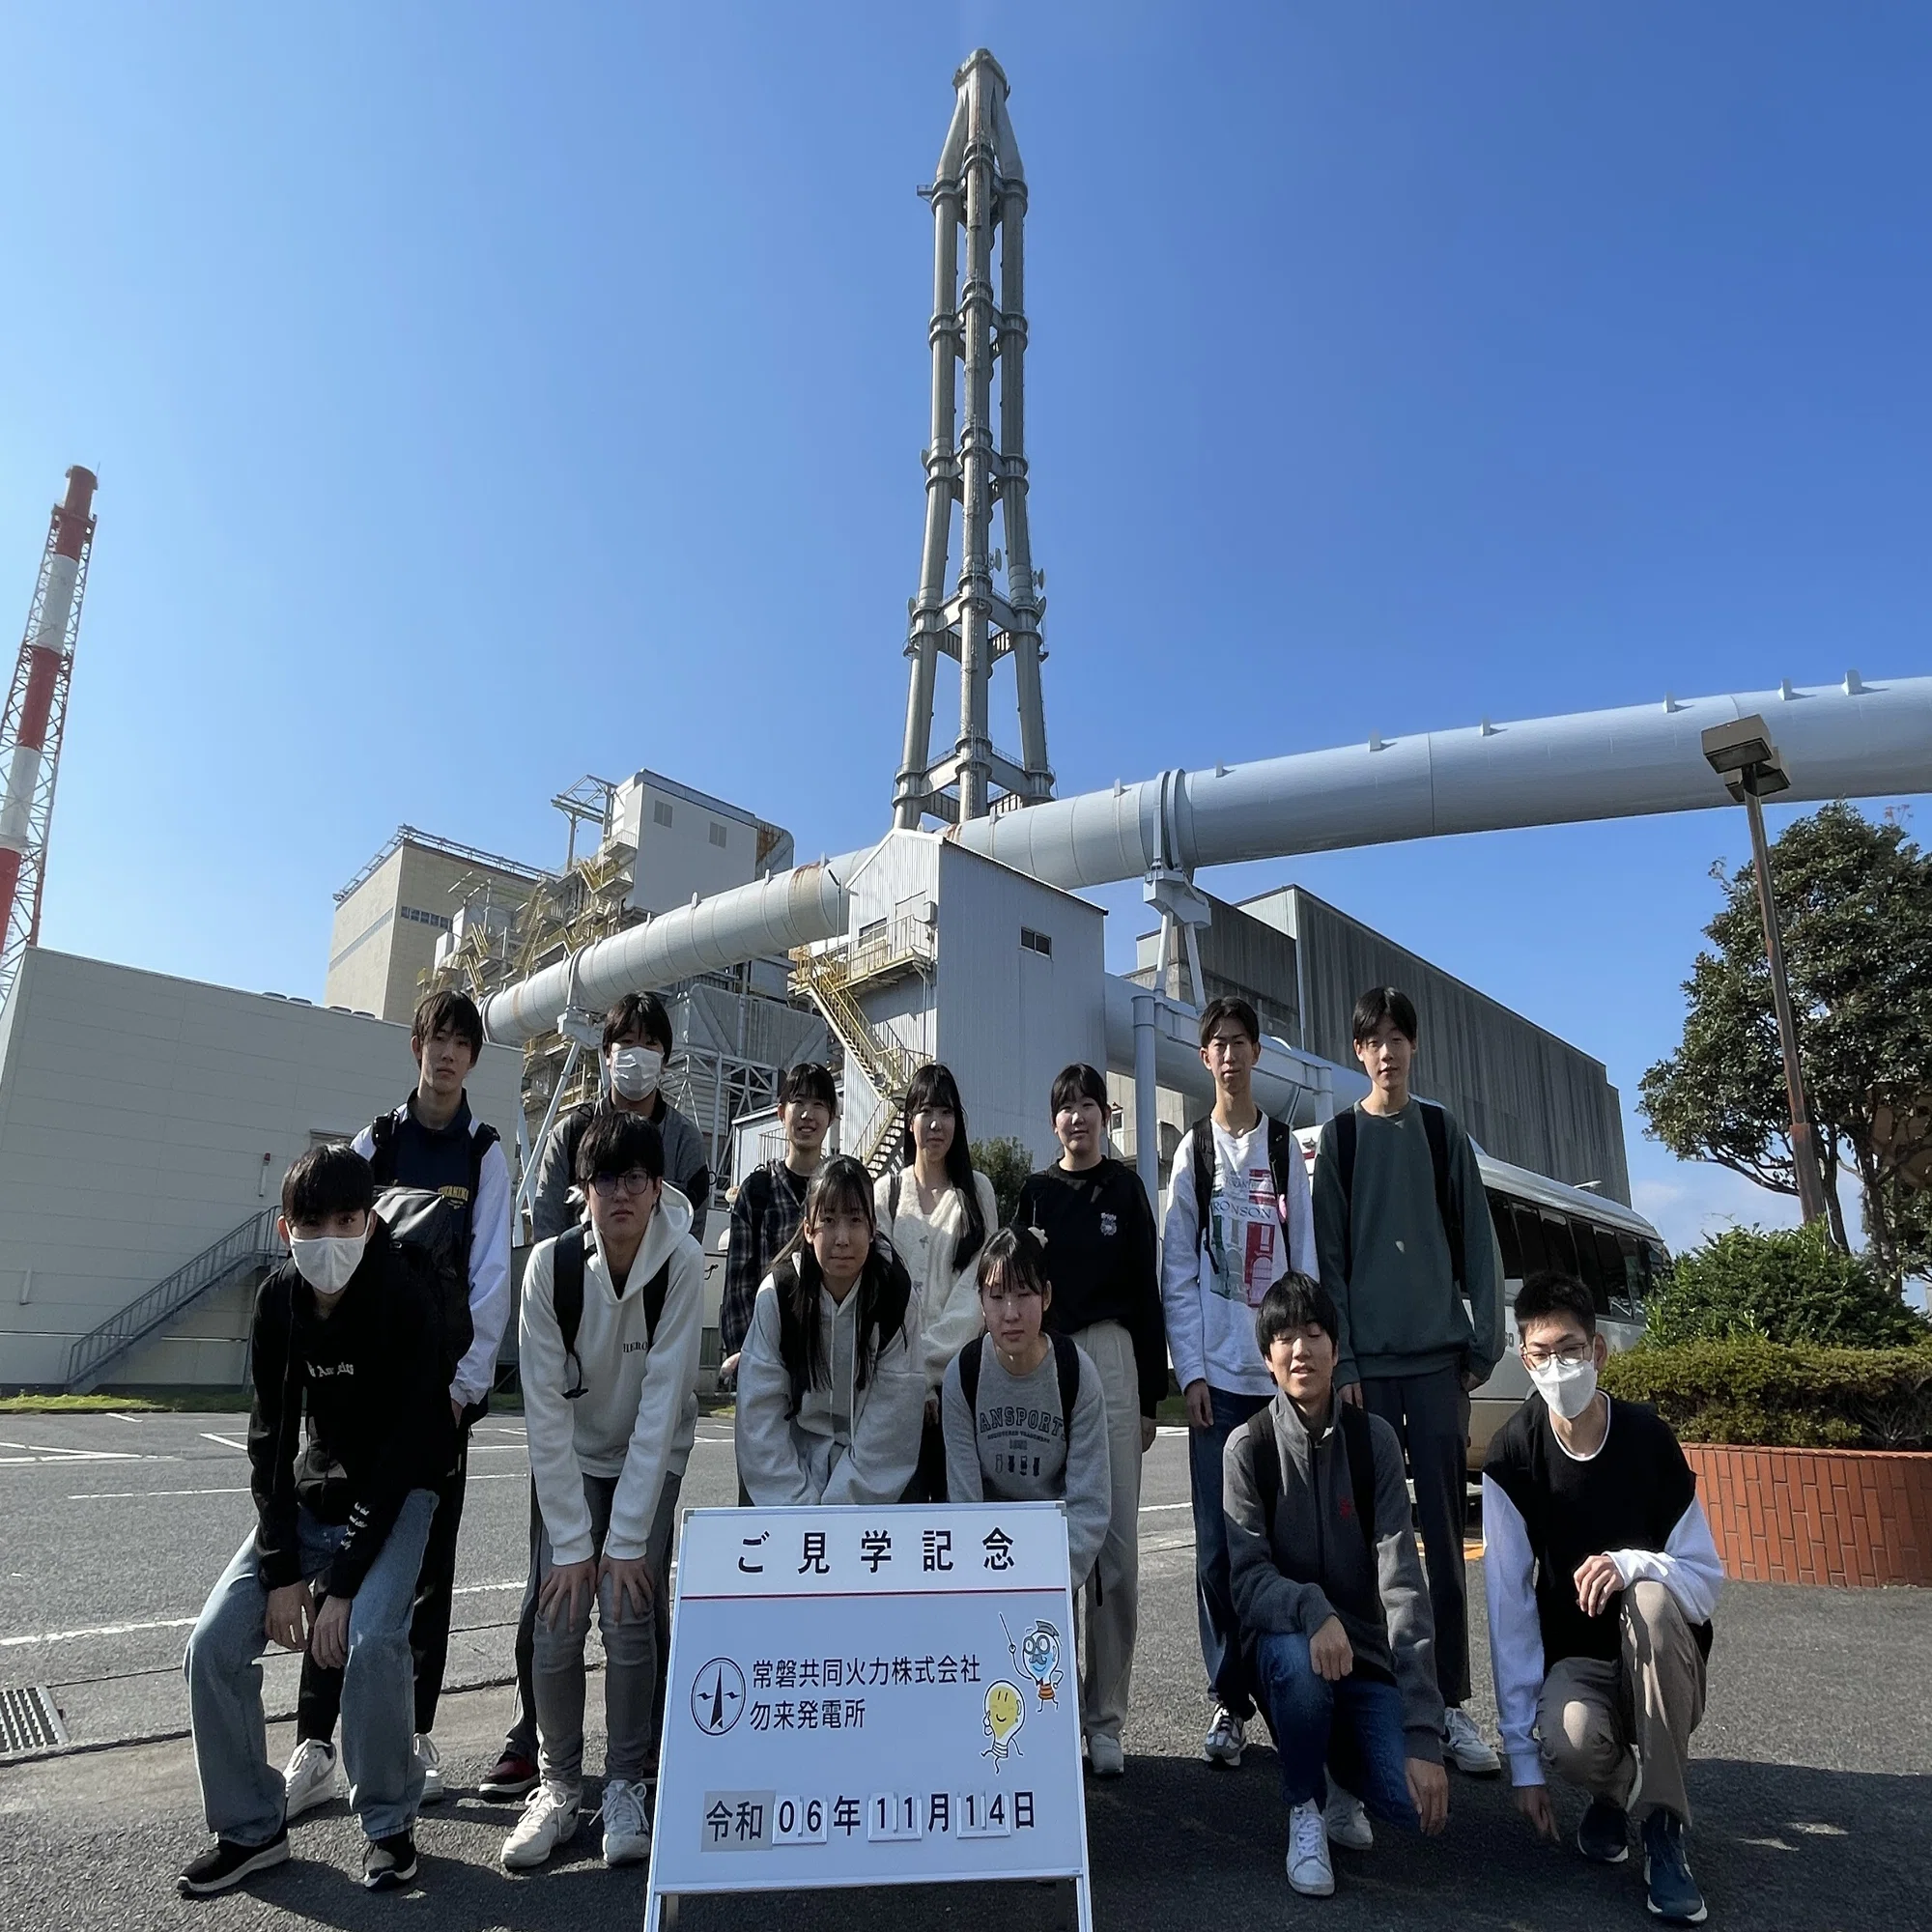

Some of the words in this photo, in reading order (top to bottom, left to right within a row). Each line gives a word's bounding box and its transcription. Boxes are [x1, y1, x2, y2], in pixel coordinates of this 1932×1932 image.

[738, 1526, 1015, 1575] ご見学記念
[752, 1654, 982, 1690] 常磐共同火力株式会社
[749, 1698, 867, 1732] 勿来発電所
